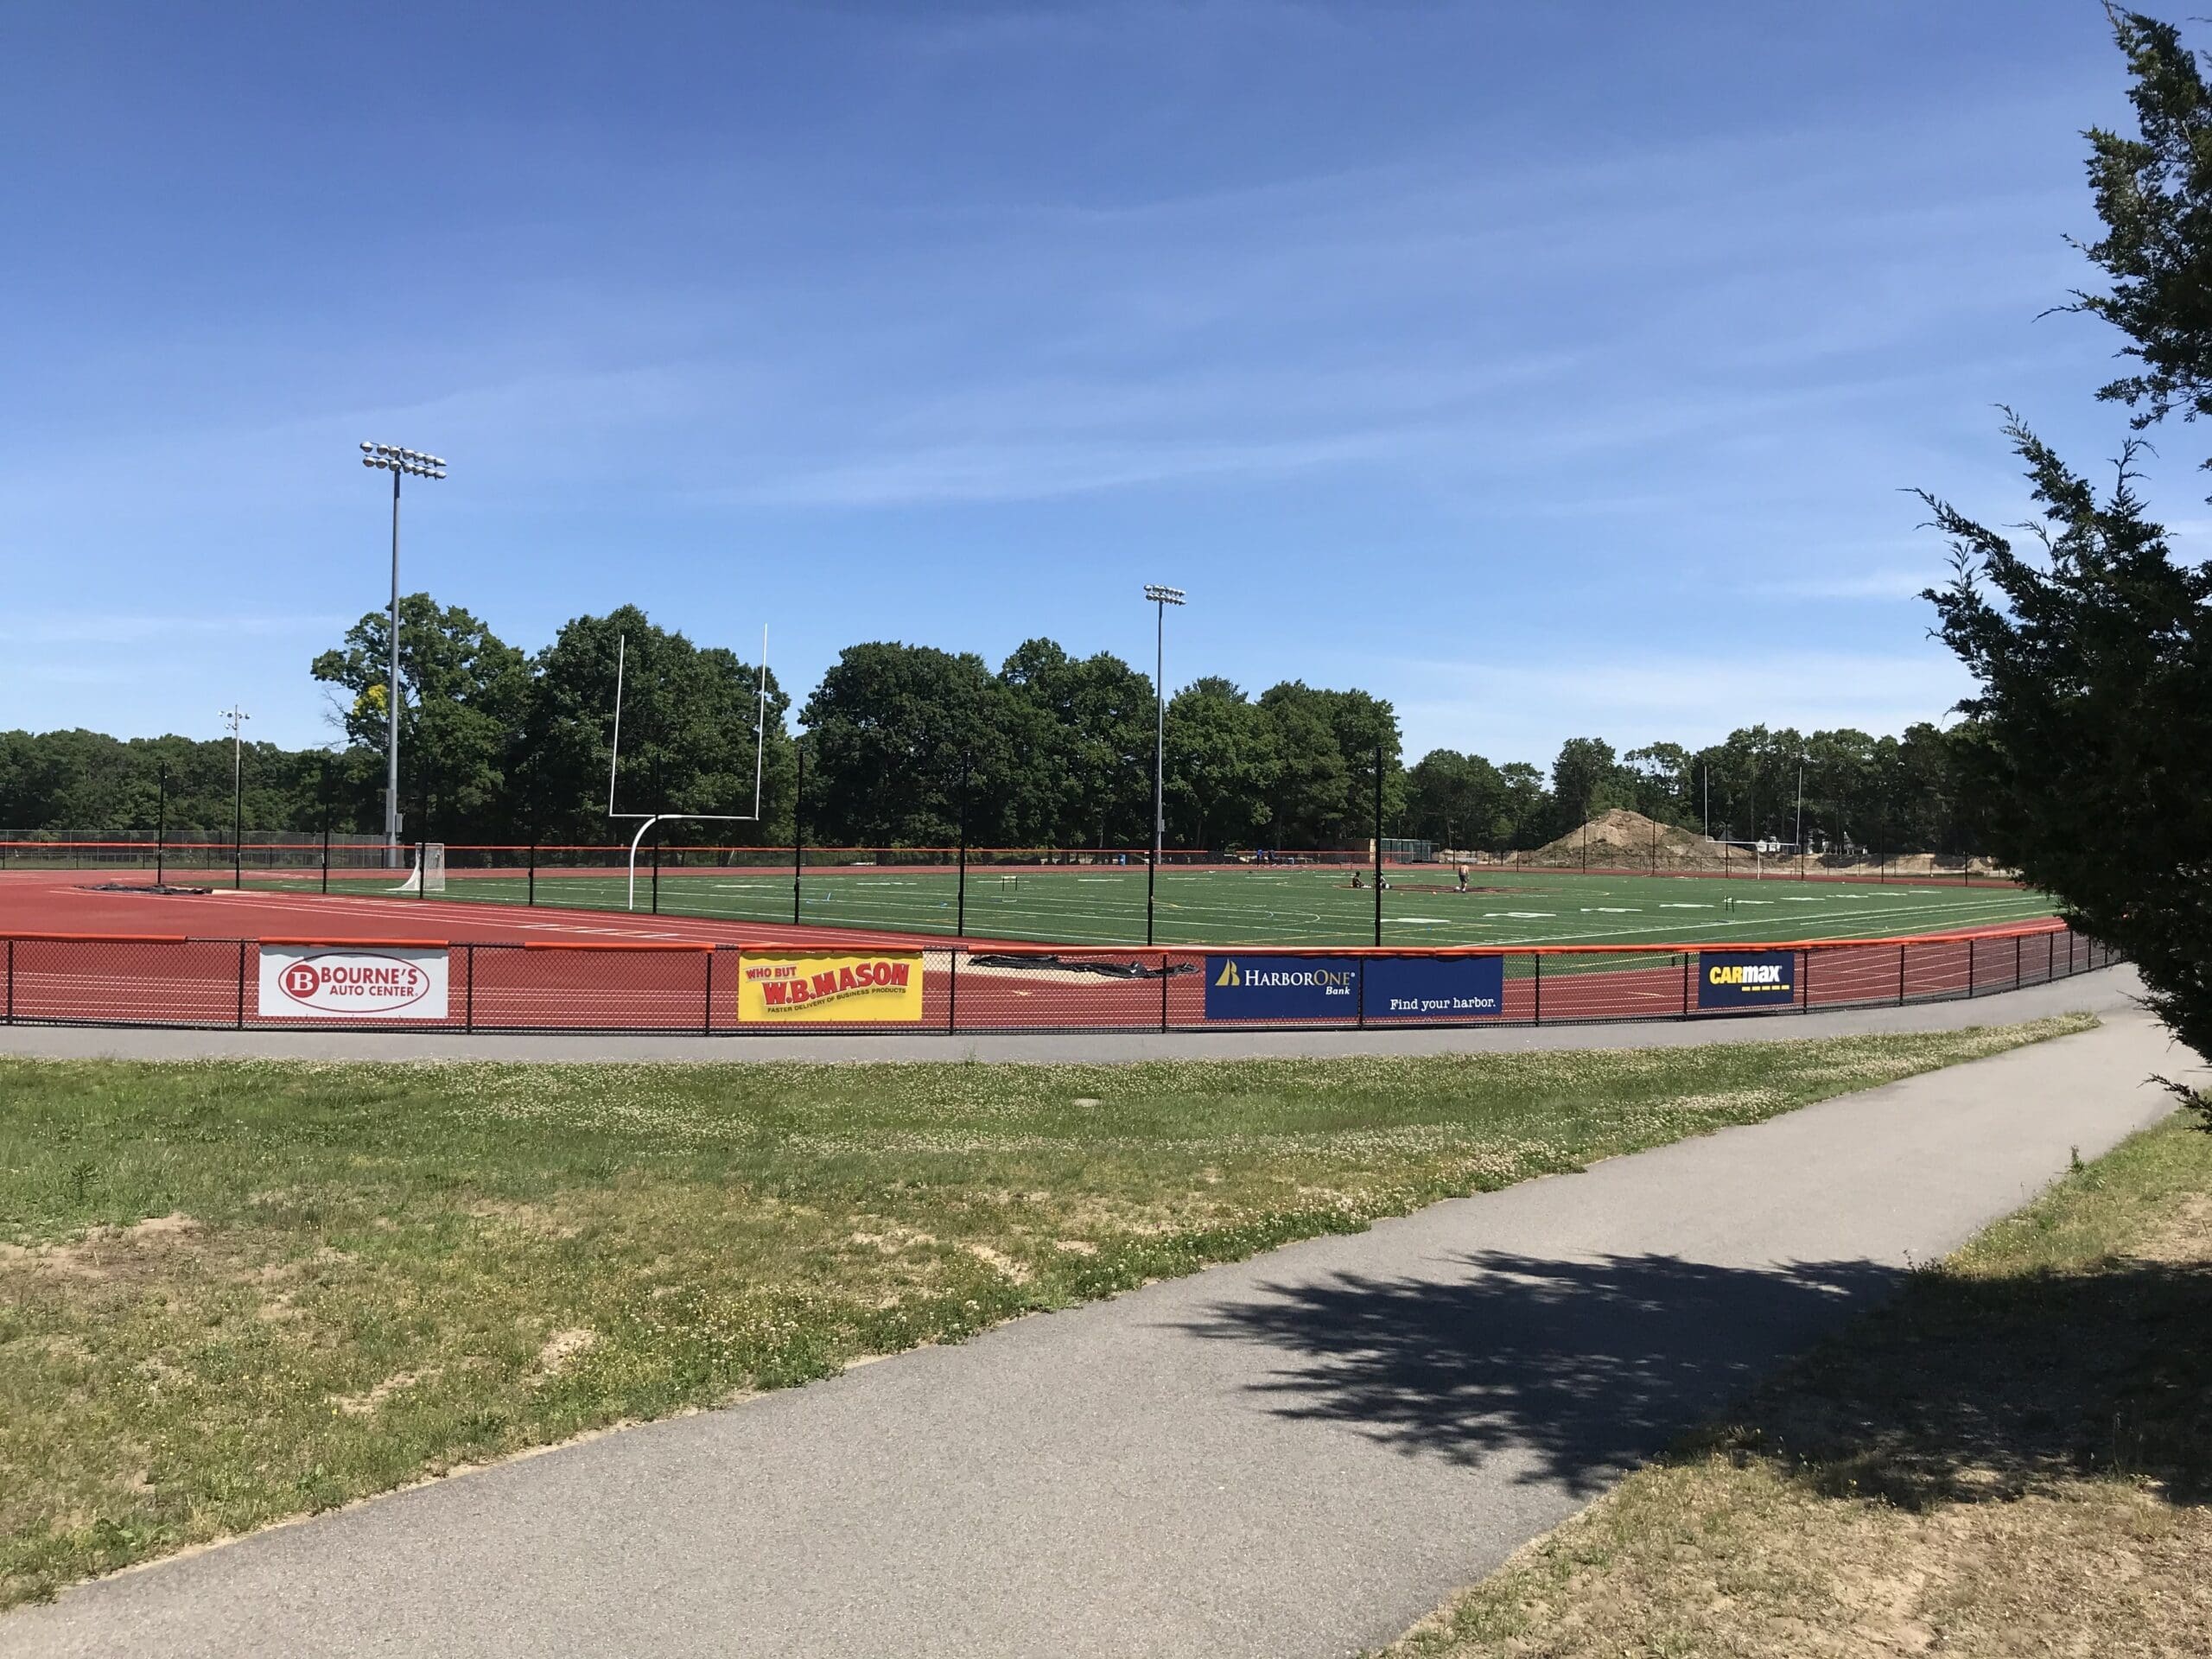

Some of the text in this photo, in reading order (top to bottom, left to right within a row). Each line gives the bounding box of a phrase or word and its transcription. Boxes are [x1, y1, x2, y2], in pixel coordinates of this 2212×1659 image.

[321, 966, 418, 985] BOURNE'S
[746, 966, 797, 980] WHO BUT
[329, 985, 365, 996] AUTO
[1325, 986, 1351, 995] Bank
[794, 999, 826, 1012] DELIVERY
[836, 988, 870, 1001] BUSINESS
[1389, 996, 1497, 1012] Find your harbor.
